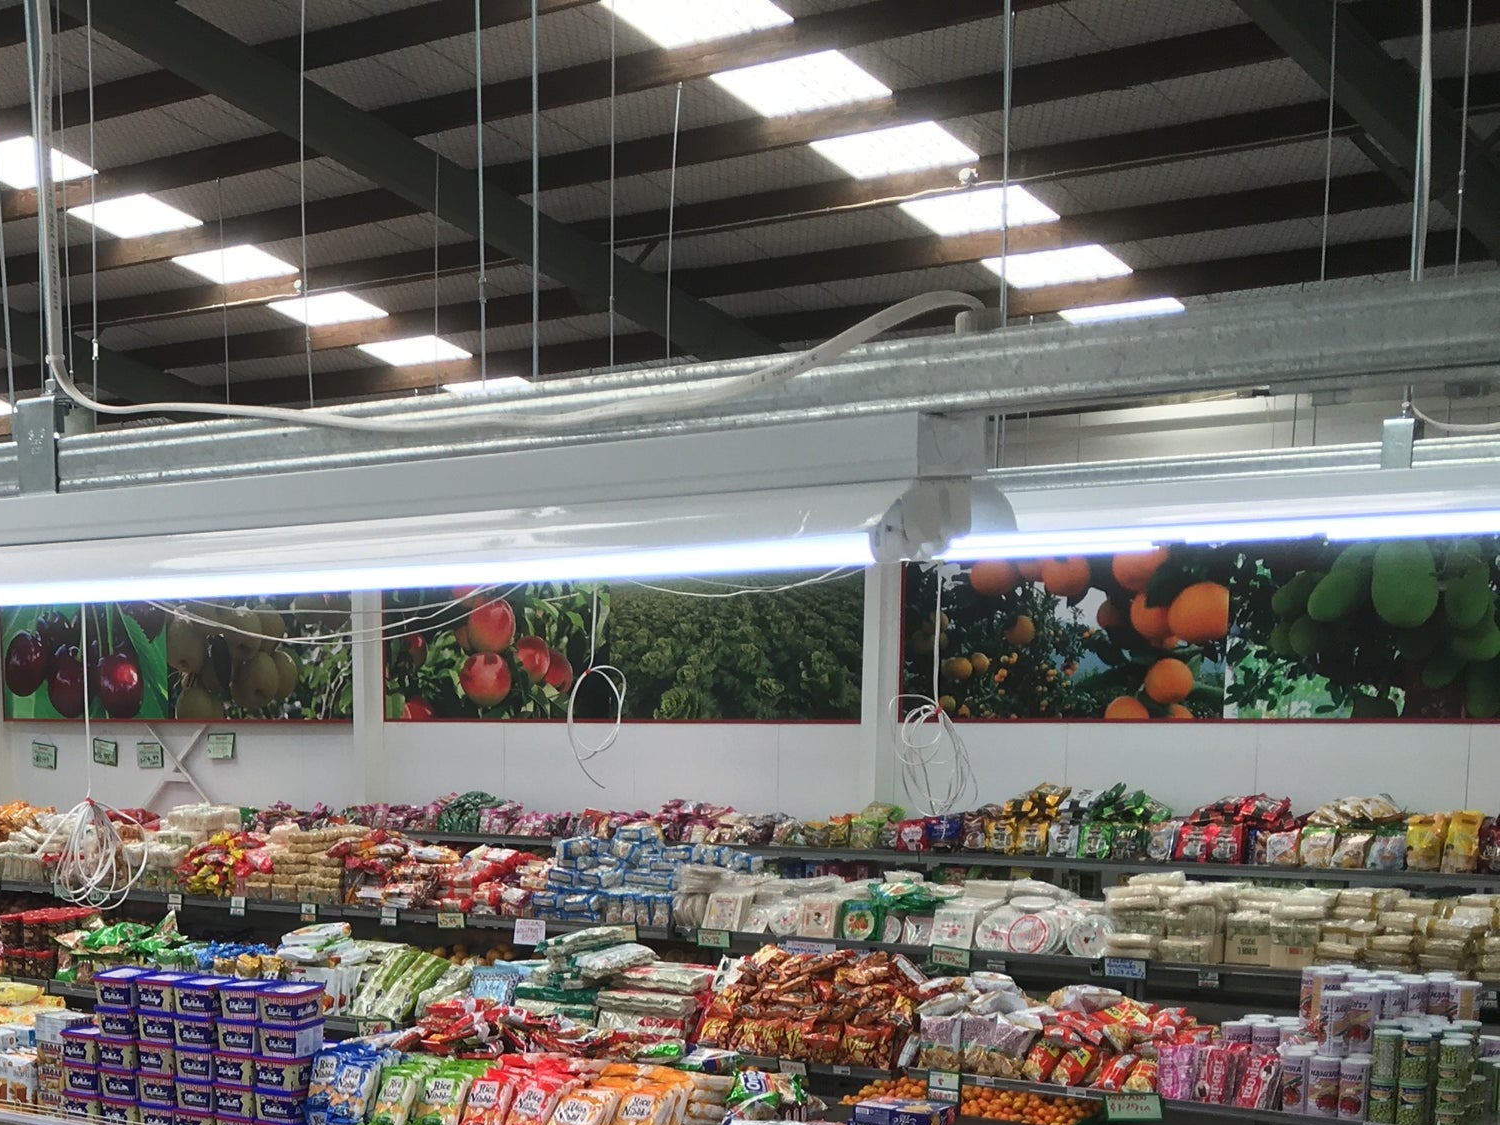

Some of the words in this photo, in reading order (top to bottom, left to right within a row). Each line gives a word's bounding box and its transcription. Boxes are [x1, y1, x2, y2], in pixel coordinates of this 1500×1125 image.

[320, 1059, 334, 1068] Rice
[434, 1080, 451, 1090] Rice
[480, 1084, 496, 1094] Rice
[525, 1090, 542, 1102] Rice
